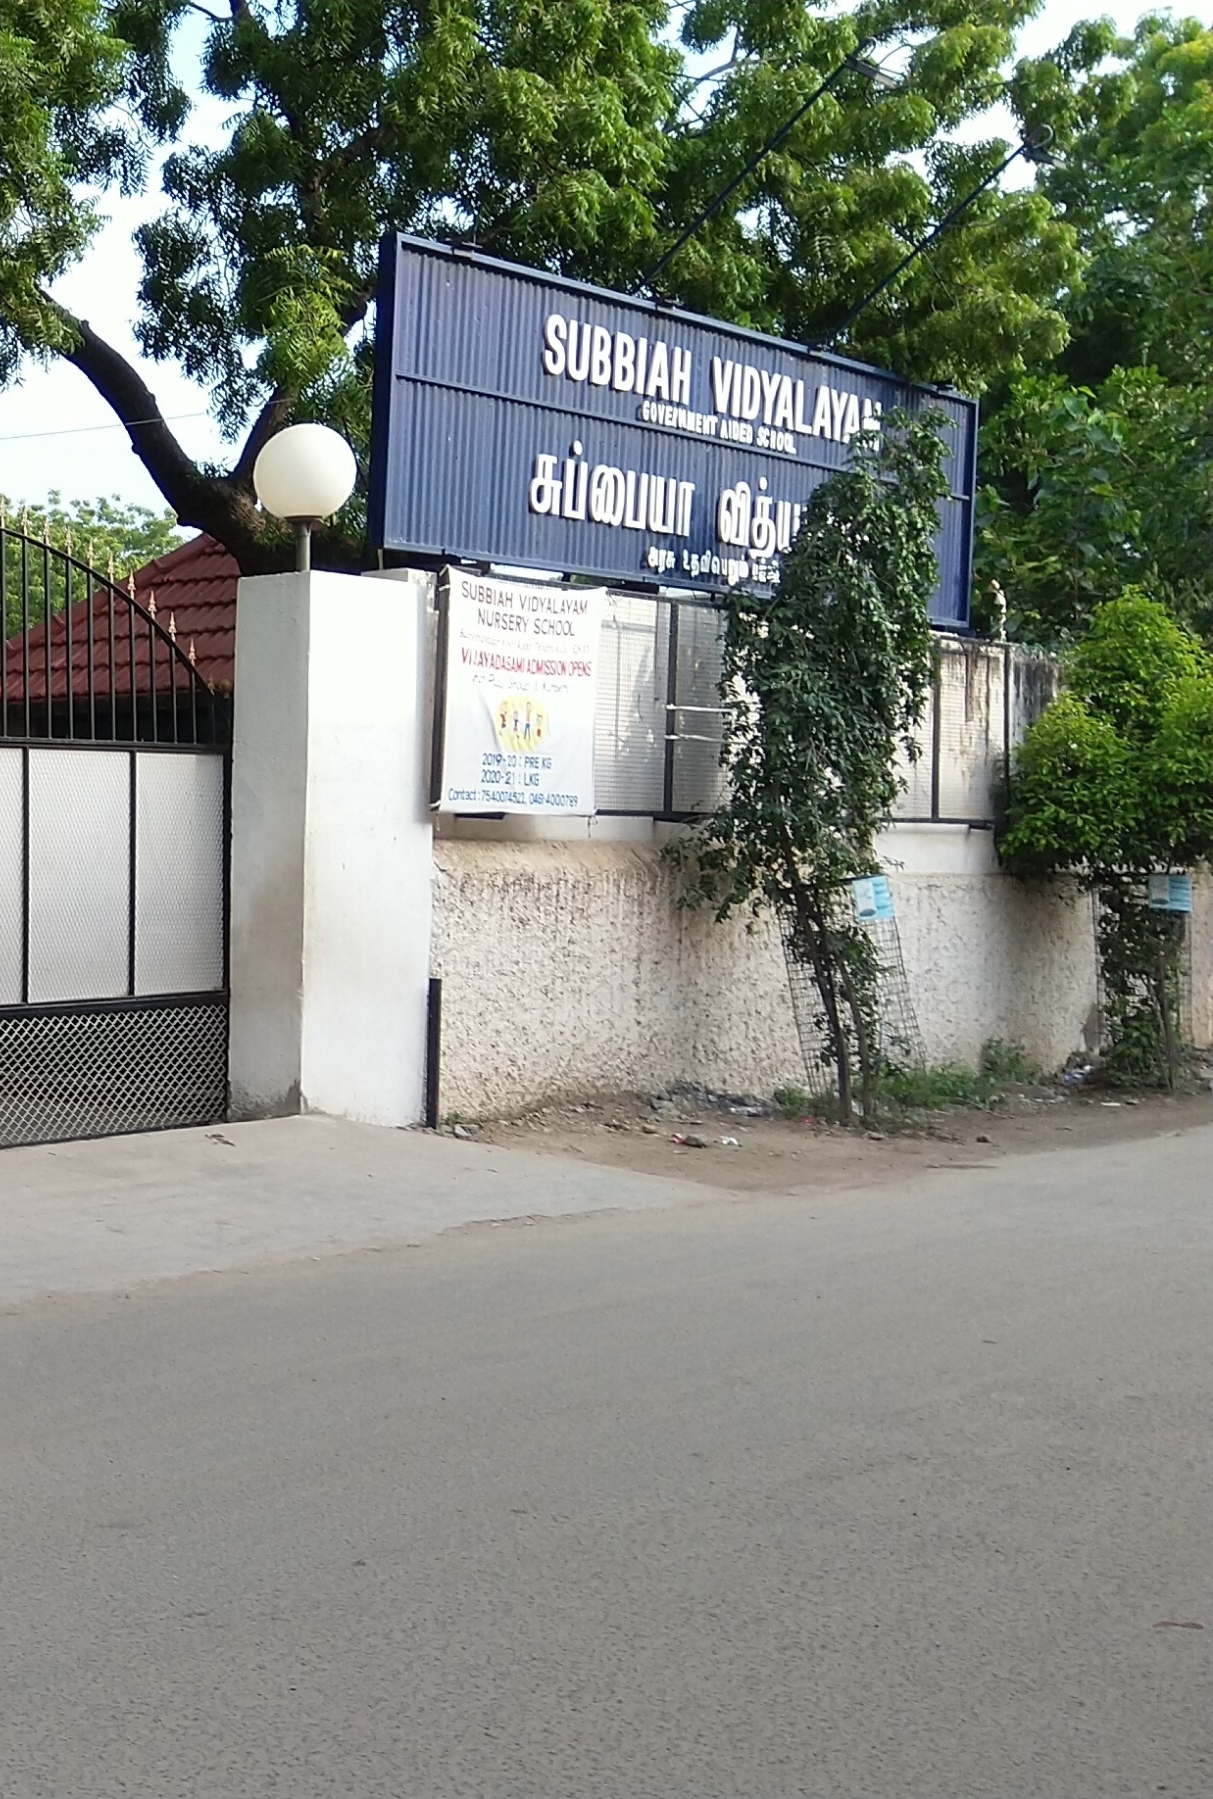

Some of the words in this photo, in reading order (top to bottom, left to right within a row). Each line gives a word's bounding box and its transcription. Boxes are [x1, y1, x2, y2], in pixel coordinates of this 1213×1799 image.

[544, 313, 693, 406] SUBBIAH
[711, 355, 883, 453] VIDYALAYAM
[642, 400, 719, 436] GOVERNMENT
[719, 419, 753, 445] AIDED
[756, 425, 797, 455] SCHOOL
[530, 439, 696, 538] சுப்பையா
[647, 546, 676, 574] அரசு
[461, 580, 514, 609] SUBBIAH
[519, 594, 588, 615] VIDYALAYAM
[477, 608, 530, 633] NURSERY
[533, 618, 576, 637] SCHOOL
[527, 657, 568, 677] ADMISSION
[569, 661, 592, 678] OPENS
[524, 755, 540, 769] PRE
[541, 757, 553, 770] KG
[523, 772, 540, 786] LKG
